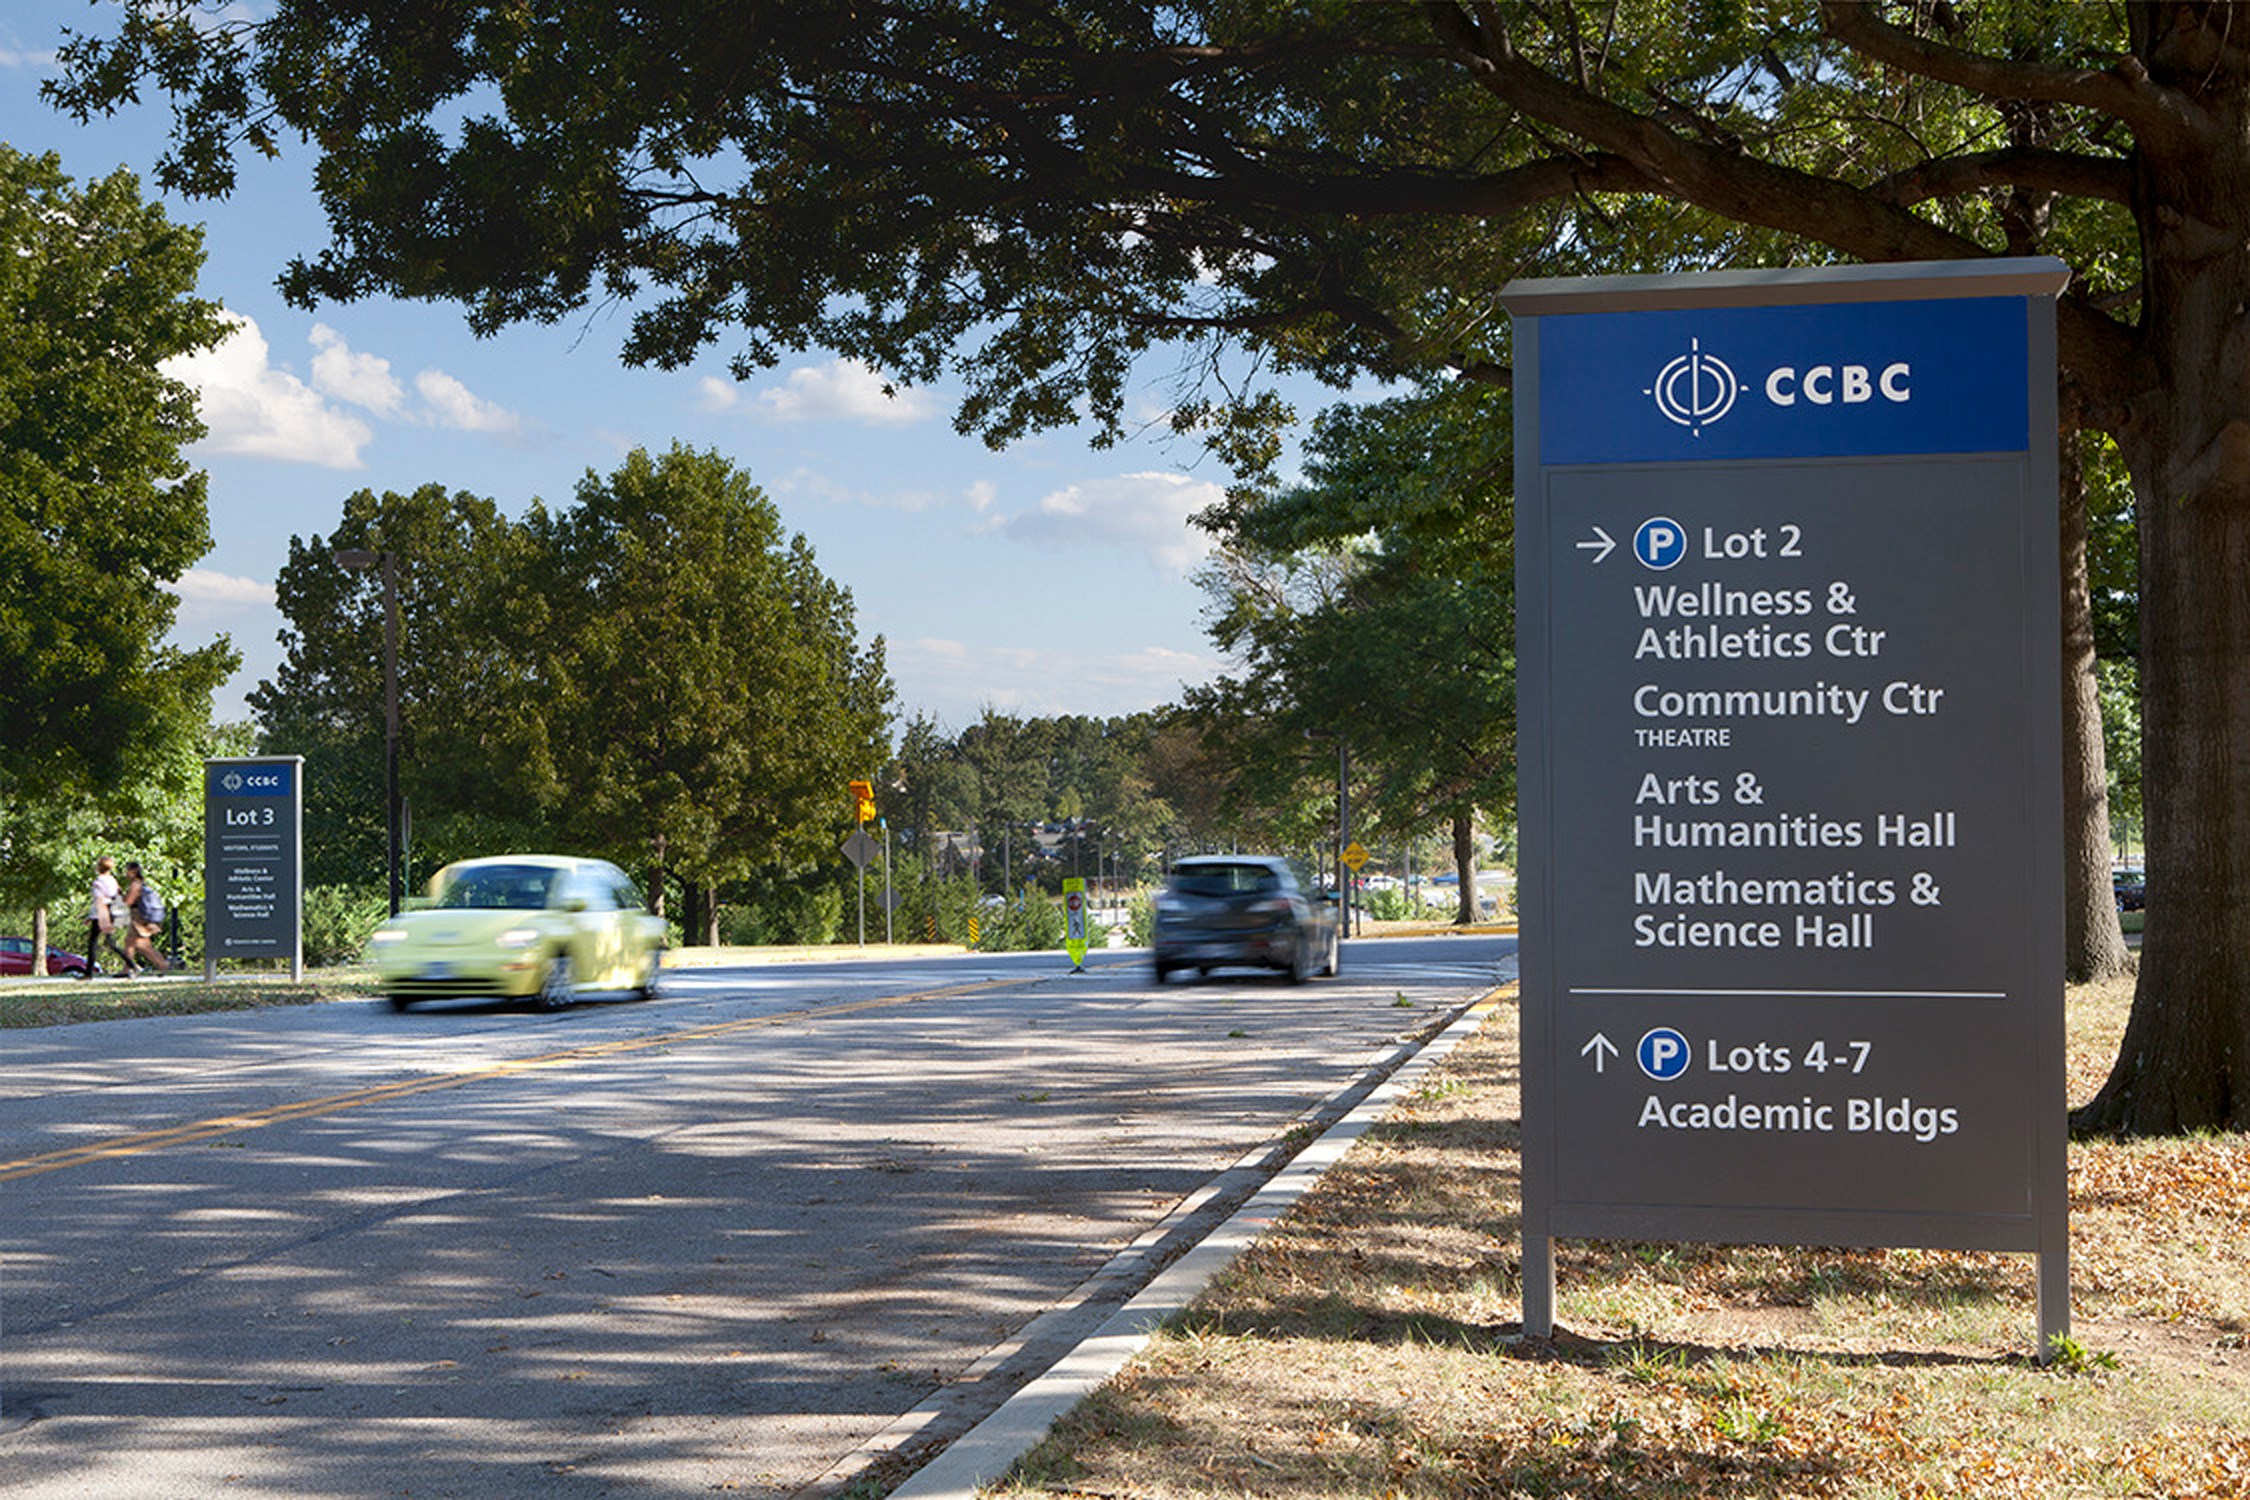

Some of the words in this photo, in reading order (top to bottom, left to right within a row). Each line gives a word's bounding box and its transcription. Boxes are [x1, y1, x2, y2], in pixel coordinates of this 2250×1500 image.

[1765, 363, 1911, 406] CCBC
[1704, 528, 1767, 559] Lot
[1779, 525, 1802, 557] 2
[1634, 583, 1812, 617] Wellness
[1826, 582, 1857, 614] &
[1634, 624, 1812, 660] Athletics
[1825, 624, 1886, 658] Ctr
[1634, 682, 1870, 724] Community
[1882, 682, 1944, 715] Ctr
[1634, 729, 1731, 747] THEATRE
[247, 776, 279, 787] CCBC
[1635, 774, 1720, 805] Arts
[1734, 773, 1764, 805] &
[227, 809, 258, 825] Lot
[263, 808, 274, 825] 3
[1634, 814, 1863, 847] Humanities
[1878, 812, 1955, 847] Hall
[1634, 871, 1896, 905] Mathematics
[1910, 873, 1941, 906] &
[1634, 914, 1781, 947] Science
[1796, 913, 1873, 948] Hall
[1708, 1039, 1792, 1073] Lots
[1803, 1041, 1871, 1074] 4-7
[1637, 1096, 1834, 1131] Academic
[1847, 1097, 1959, 1142] Bldgs
